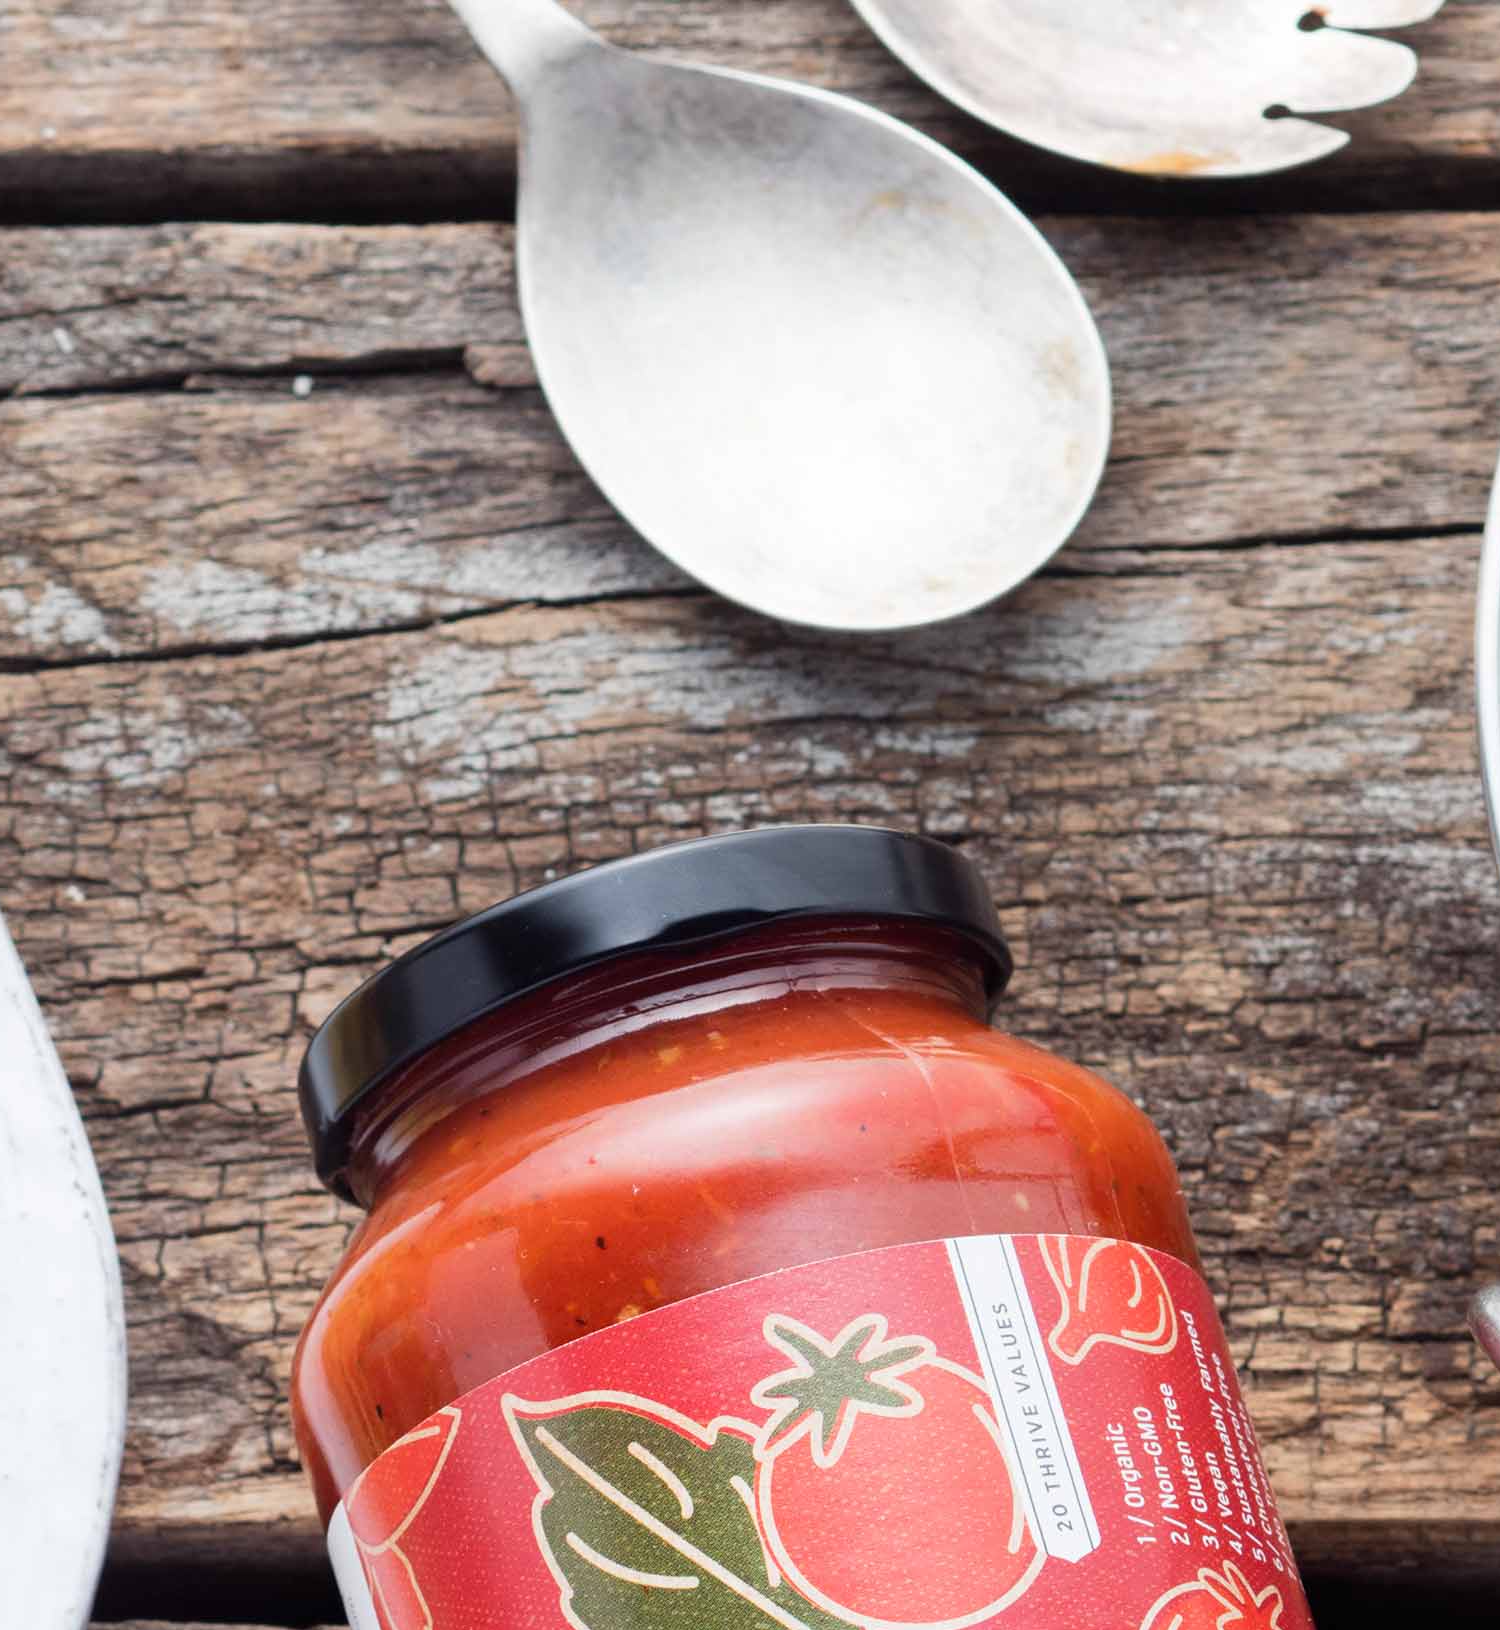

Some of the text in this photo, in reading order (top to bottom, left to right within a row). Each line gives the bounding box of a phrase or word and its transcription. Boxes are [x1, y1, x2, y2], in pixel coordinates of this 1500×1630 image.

[1180, 1310, 1216, 1393] Farmed
[992, 1303, 1074, 1532] 20 THRIVE VALUES
[1105, 1422, 1146, 1508] Organic
[1133, 1407, 1180, 1510] Non-GMO
[1159, 1383, 1209, 1514] Gluten-Free
[1208, 1398, 1256, 1528] Sustainably
[1204, 1451, 1233, 1518] Vegan
